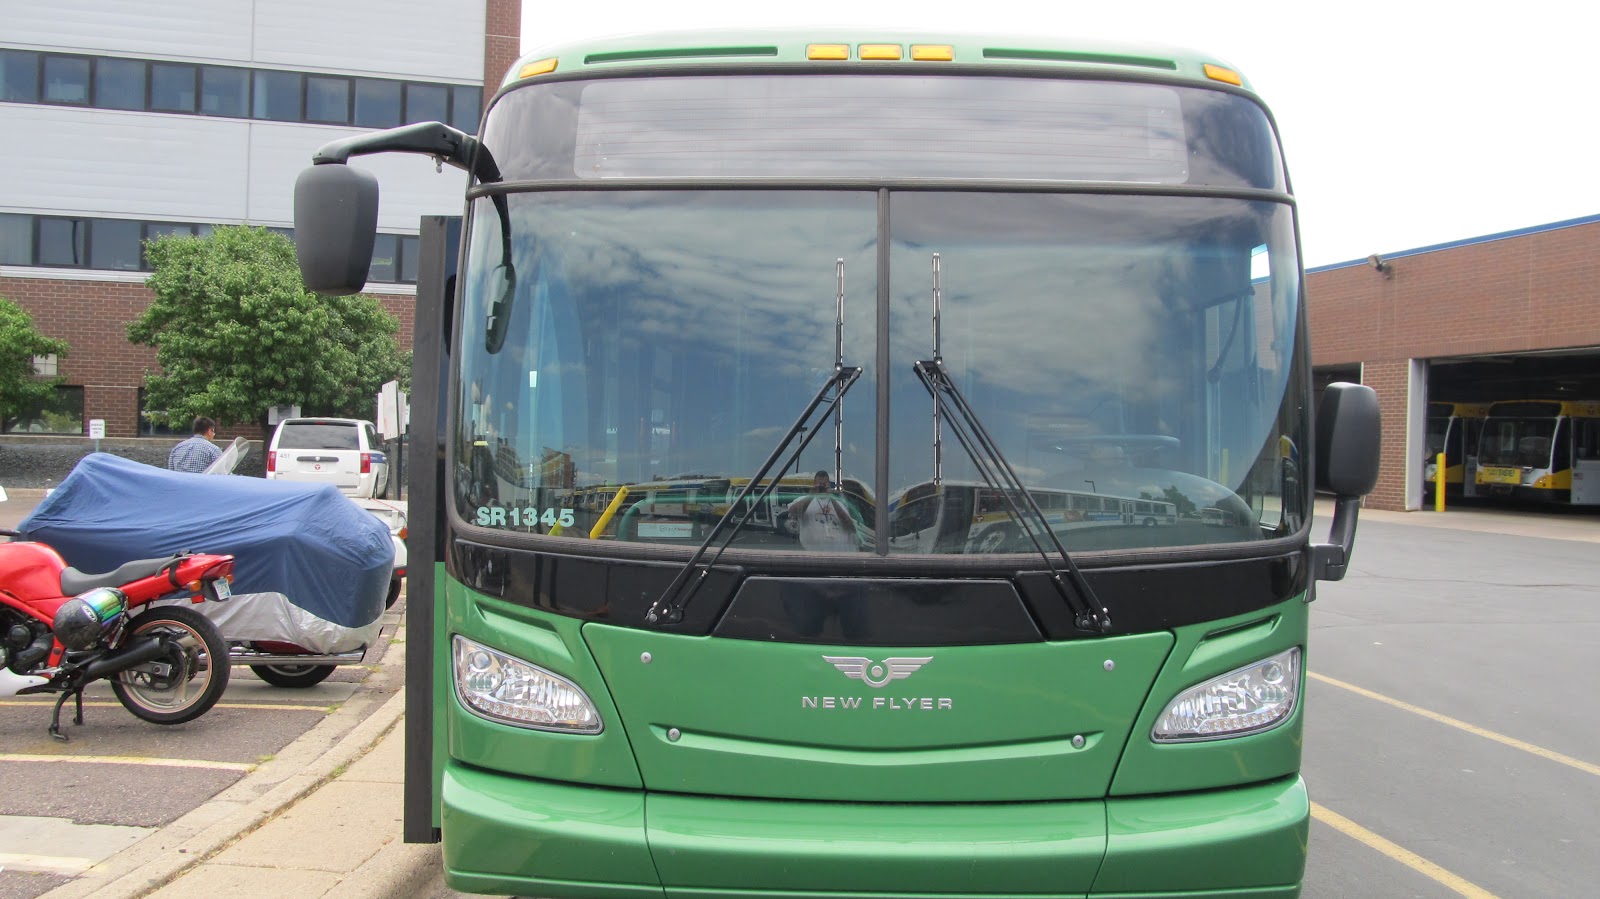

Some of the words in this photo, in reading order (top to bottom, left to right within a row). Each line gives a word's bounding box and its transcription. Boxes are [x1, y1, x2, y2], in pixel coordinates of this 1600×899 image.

[476, 506, 575, 528] SR1345
[802, 696, 862, 709] NEW
[872, 697, 953, 710] FLYER
